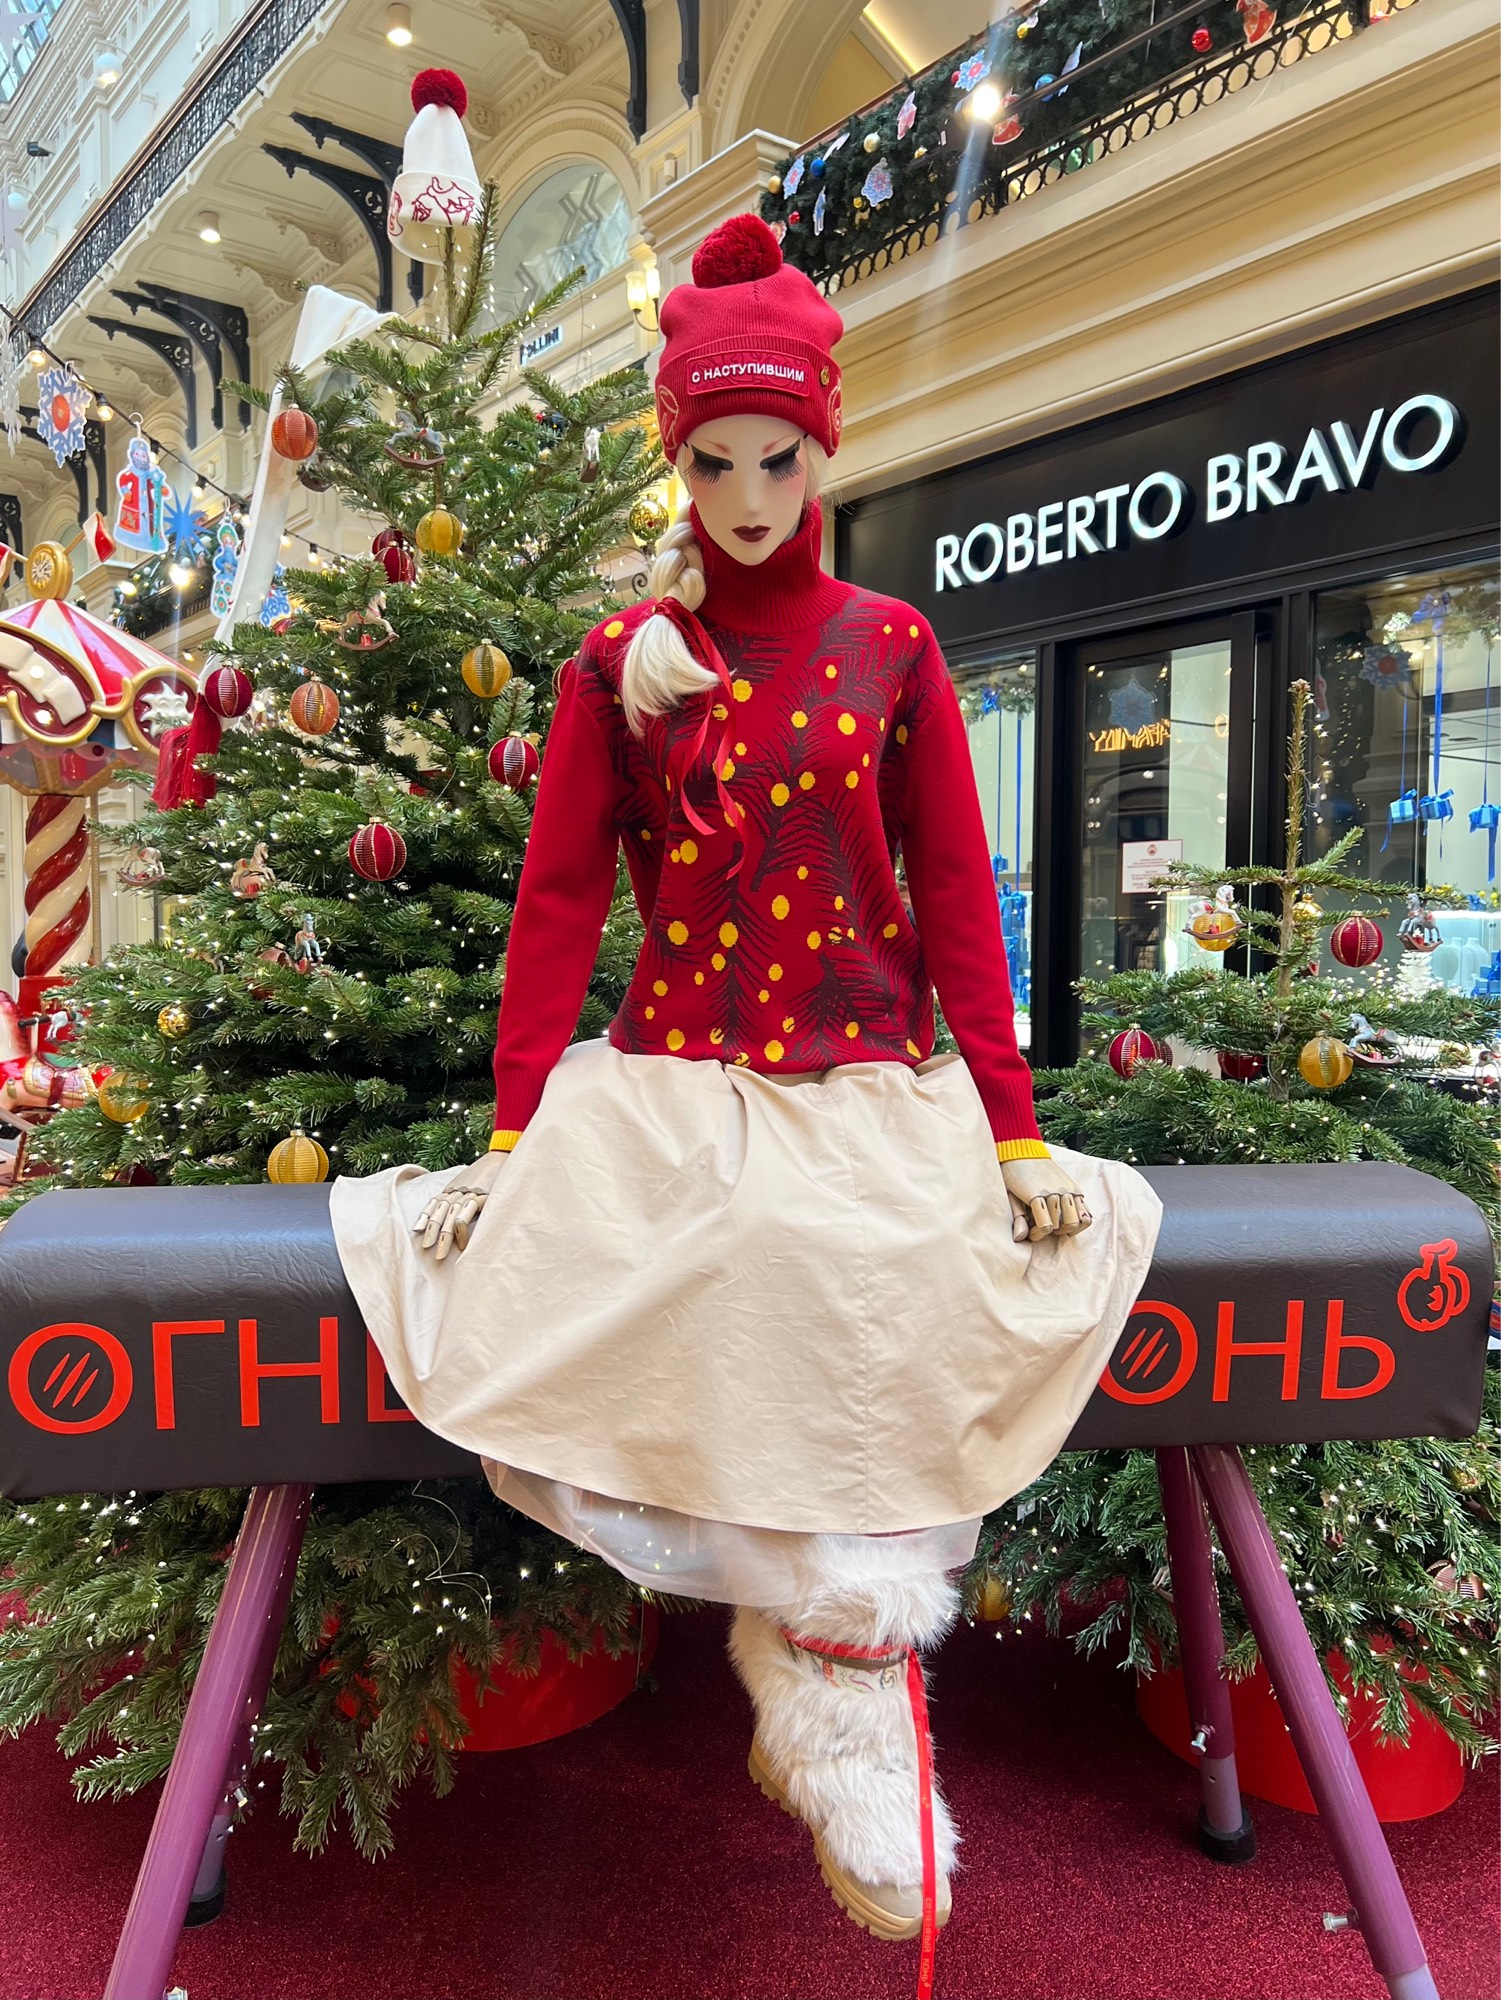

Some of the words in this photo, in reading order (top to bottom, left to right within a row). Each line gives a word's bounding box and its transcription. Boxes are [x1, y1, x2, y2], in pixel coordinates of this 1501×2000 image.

[692, 372, 700, 383] С
[704, 363, 805, 383] НАСТУПИВШИМ
[935, 471, 1184, 592] ROBERTO
[1206, 394, 1458, 523] BRAVO
